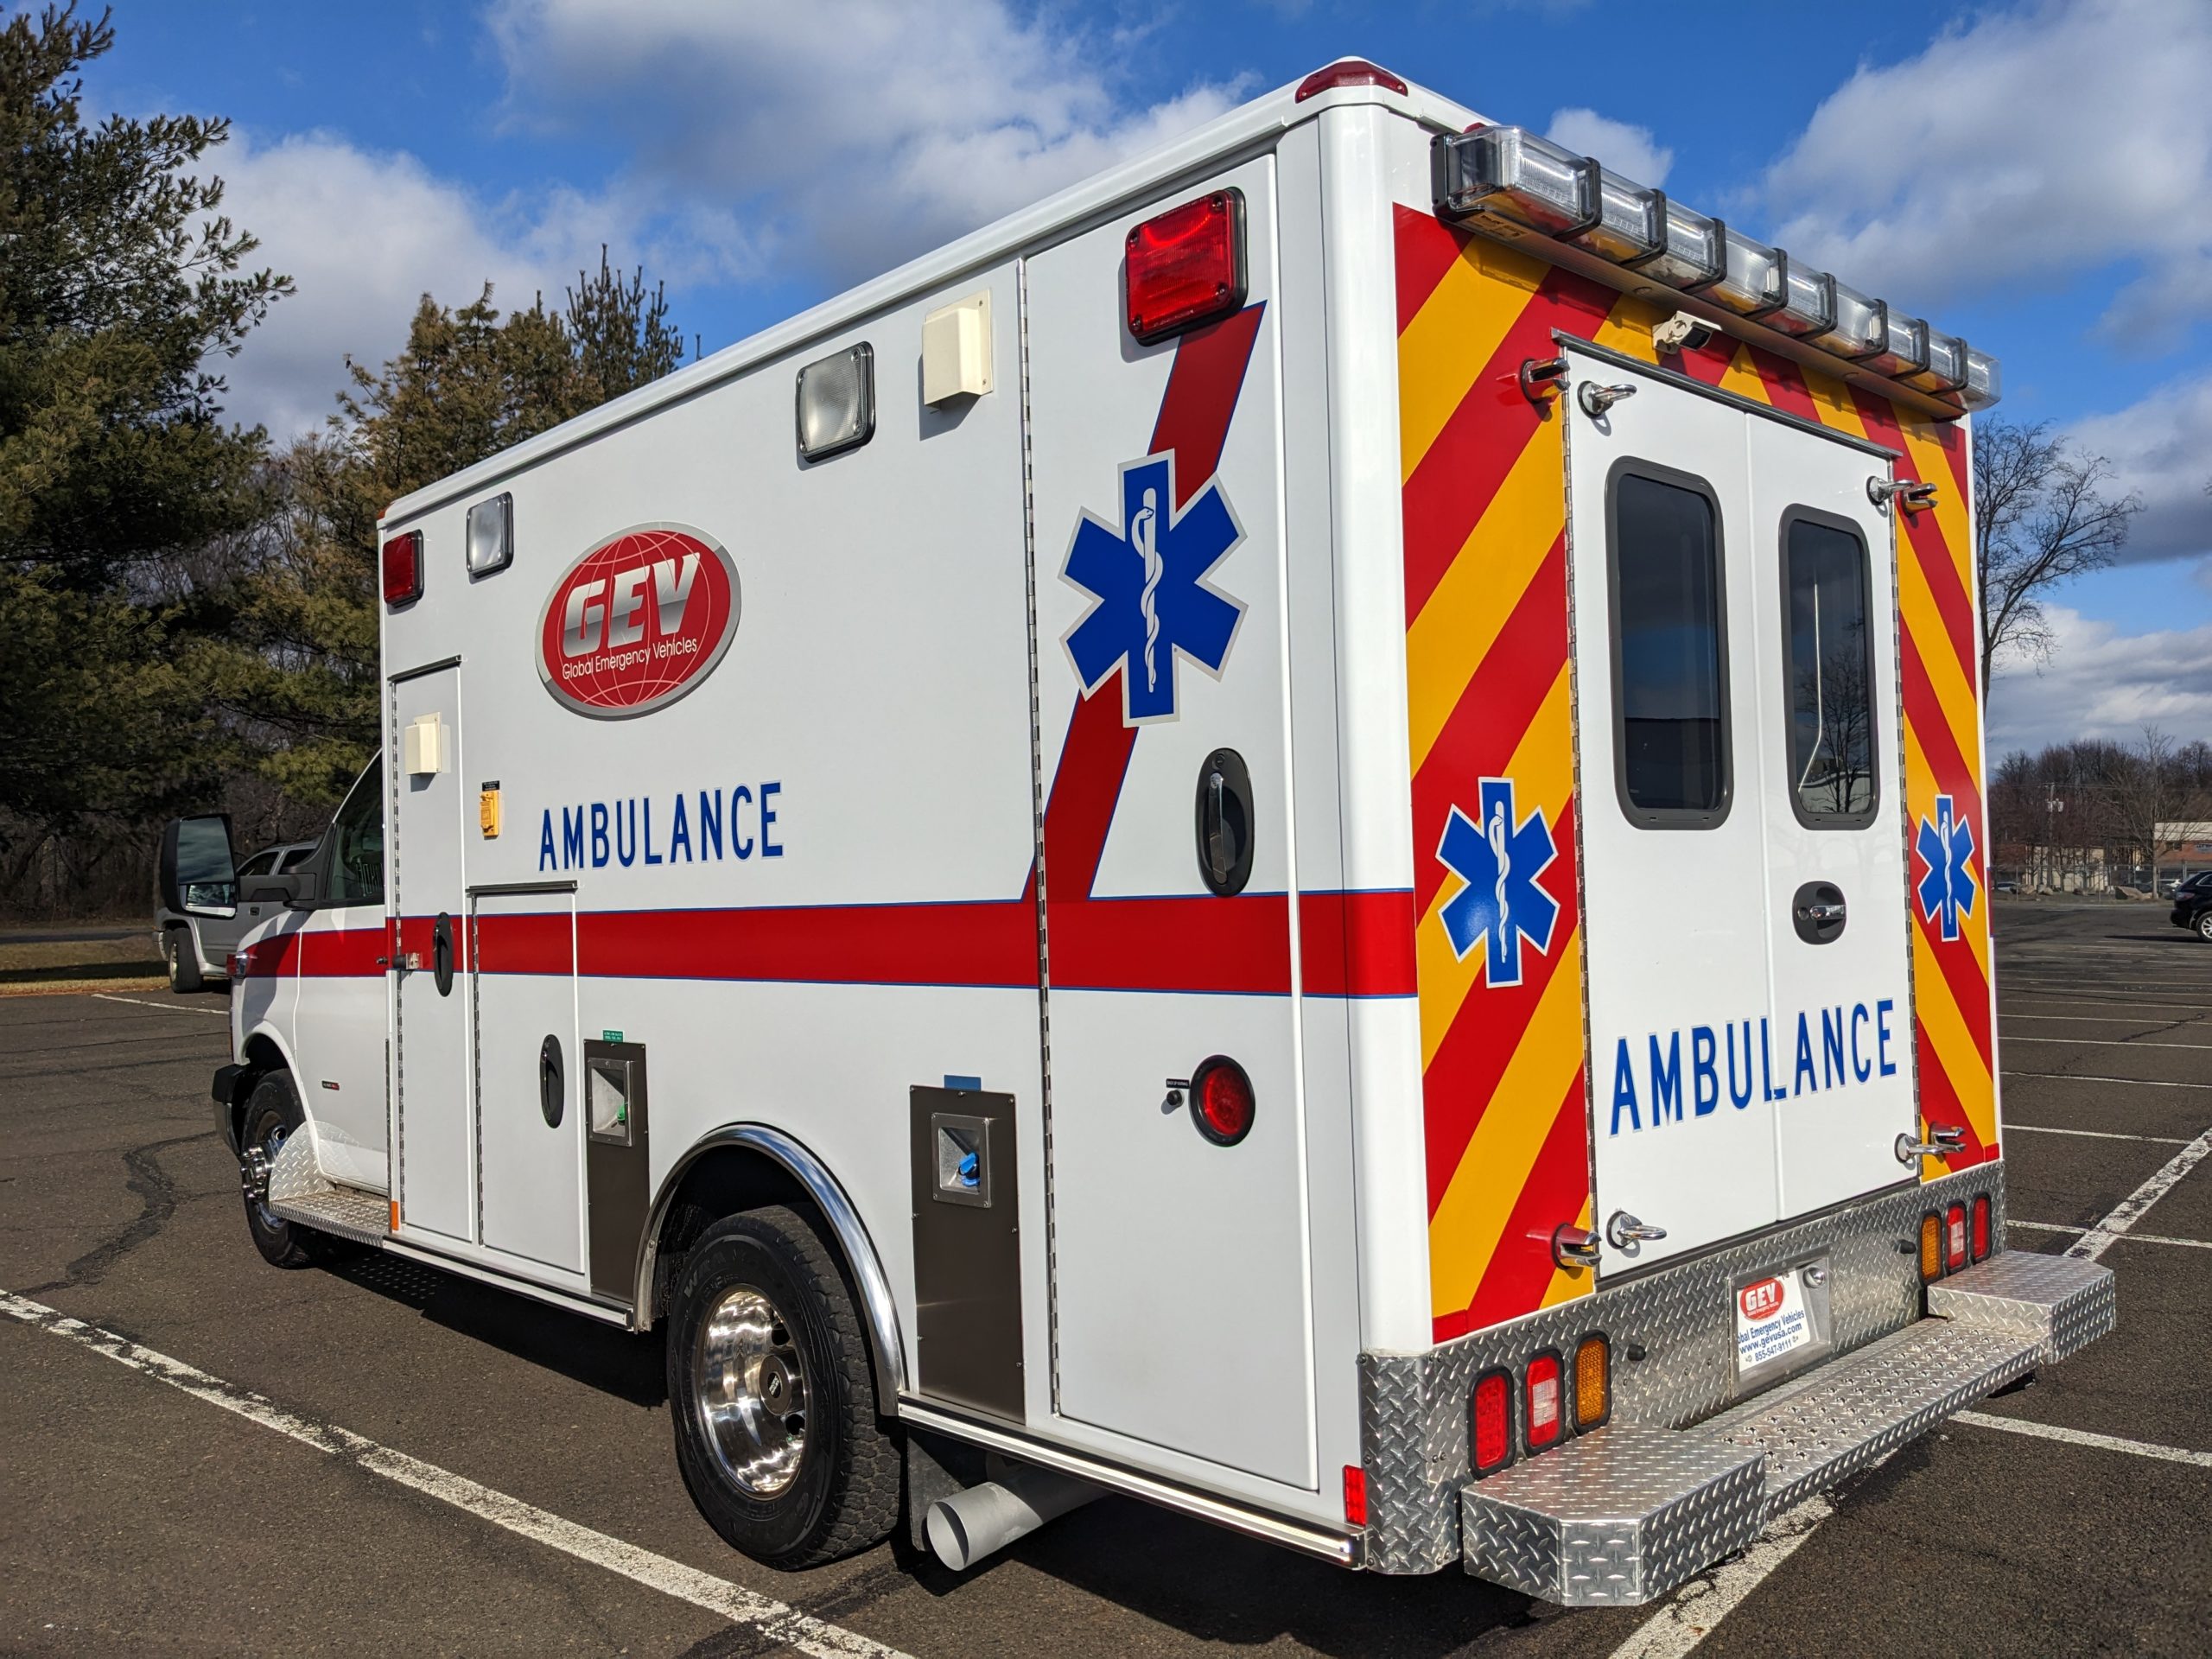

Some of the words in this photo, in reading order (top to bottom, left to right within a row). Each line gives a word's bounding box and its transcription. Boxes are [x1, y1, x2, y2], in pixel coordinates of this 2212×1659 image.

[563, 551, 701, 658] GEV
[562, 658, 594, 680] Global
[595, 647, 651, 671] Emergency
[652, 637, 698, 660] Vehicles
[538, 780, 785, 873] AMBULANCE
[1609, 998, 1897, 1139] AMBULANCE
[1745, 1282, 1776, 1312] GEV
[1738, 1330, 1750, 1344] obal
[1750, 1319, 1781, 1339] Emergency
[1781, 1310, 1804, 1326] Vehicles
[1739, 1322, 1802, 1354] www.gevusa.com
[1754, 1338, 1792, 1362] 855-547-9111
